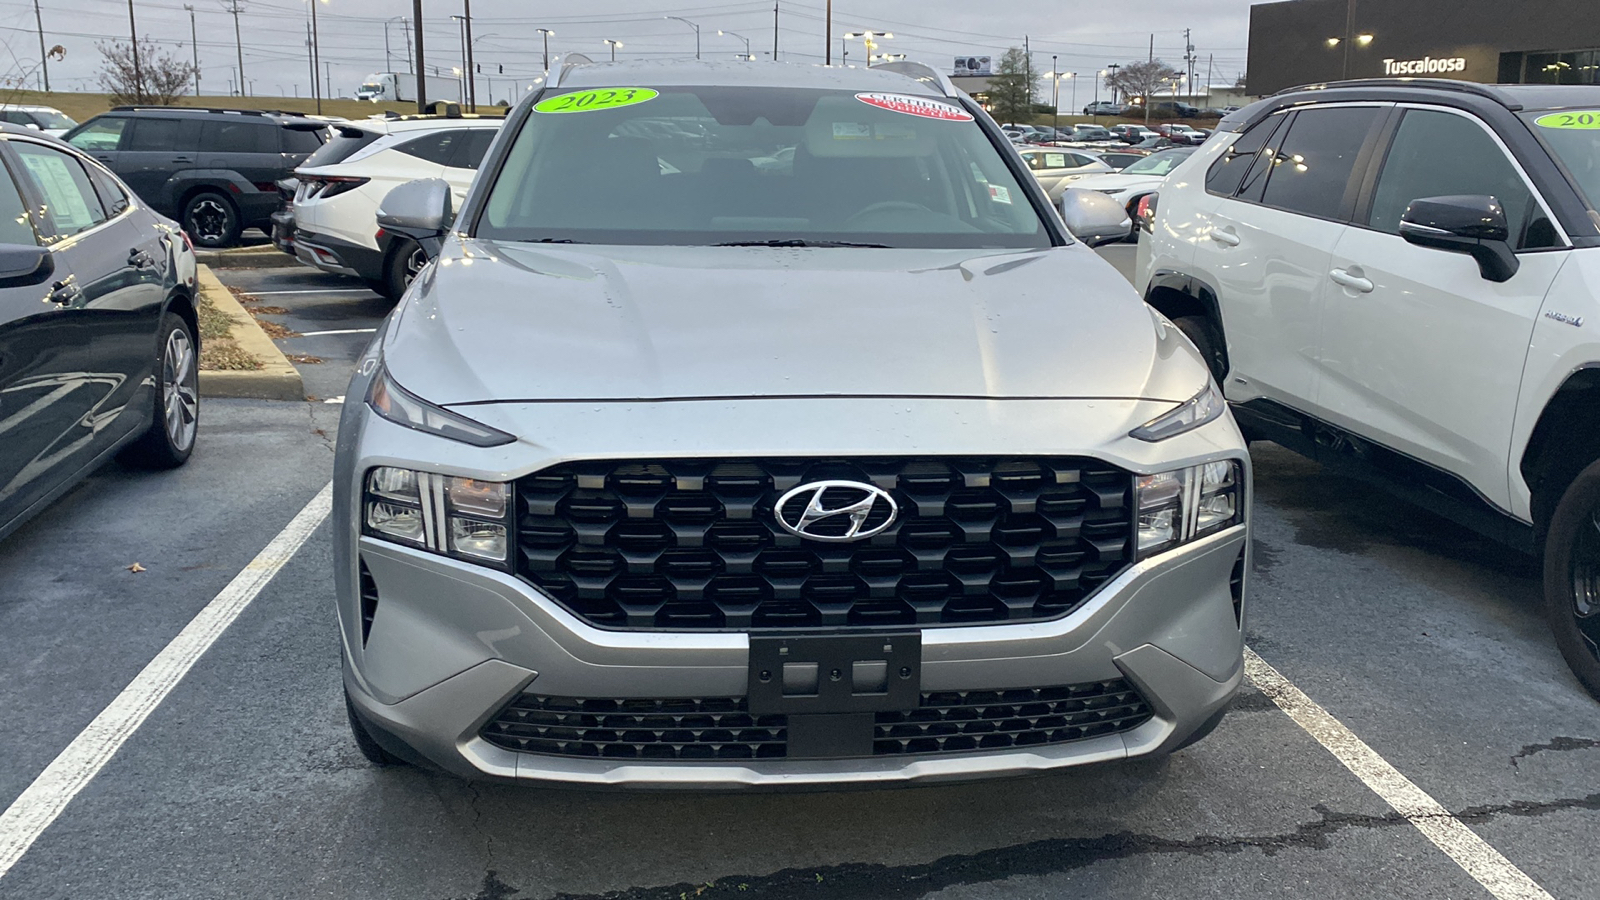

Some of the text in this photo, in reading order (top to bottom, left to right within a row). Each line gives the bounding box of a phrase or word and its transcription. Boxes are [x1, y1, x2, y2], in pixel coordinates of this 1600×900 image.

[1383, 56, 1466, 75] Tuscaloosa
[554, 89, 637, 110] 2023
[870, 93, 960, 114] CERTIFIED
[1559, 113, 1600, 126] 20
